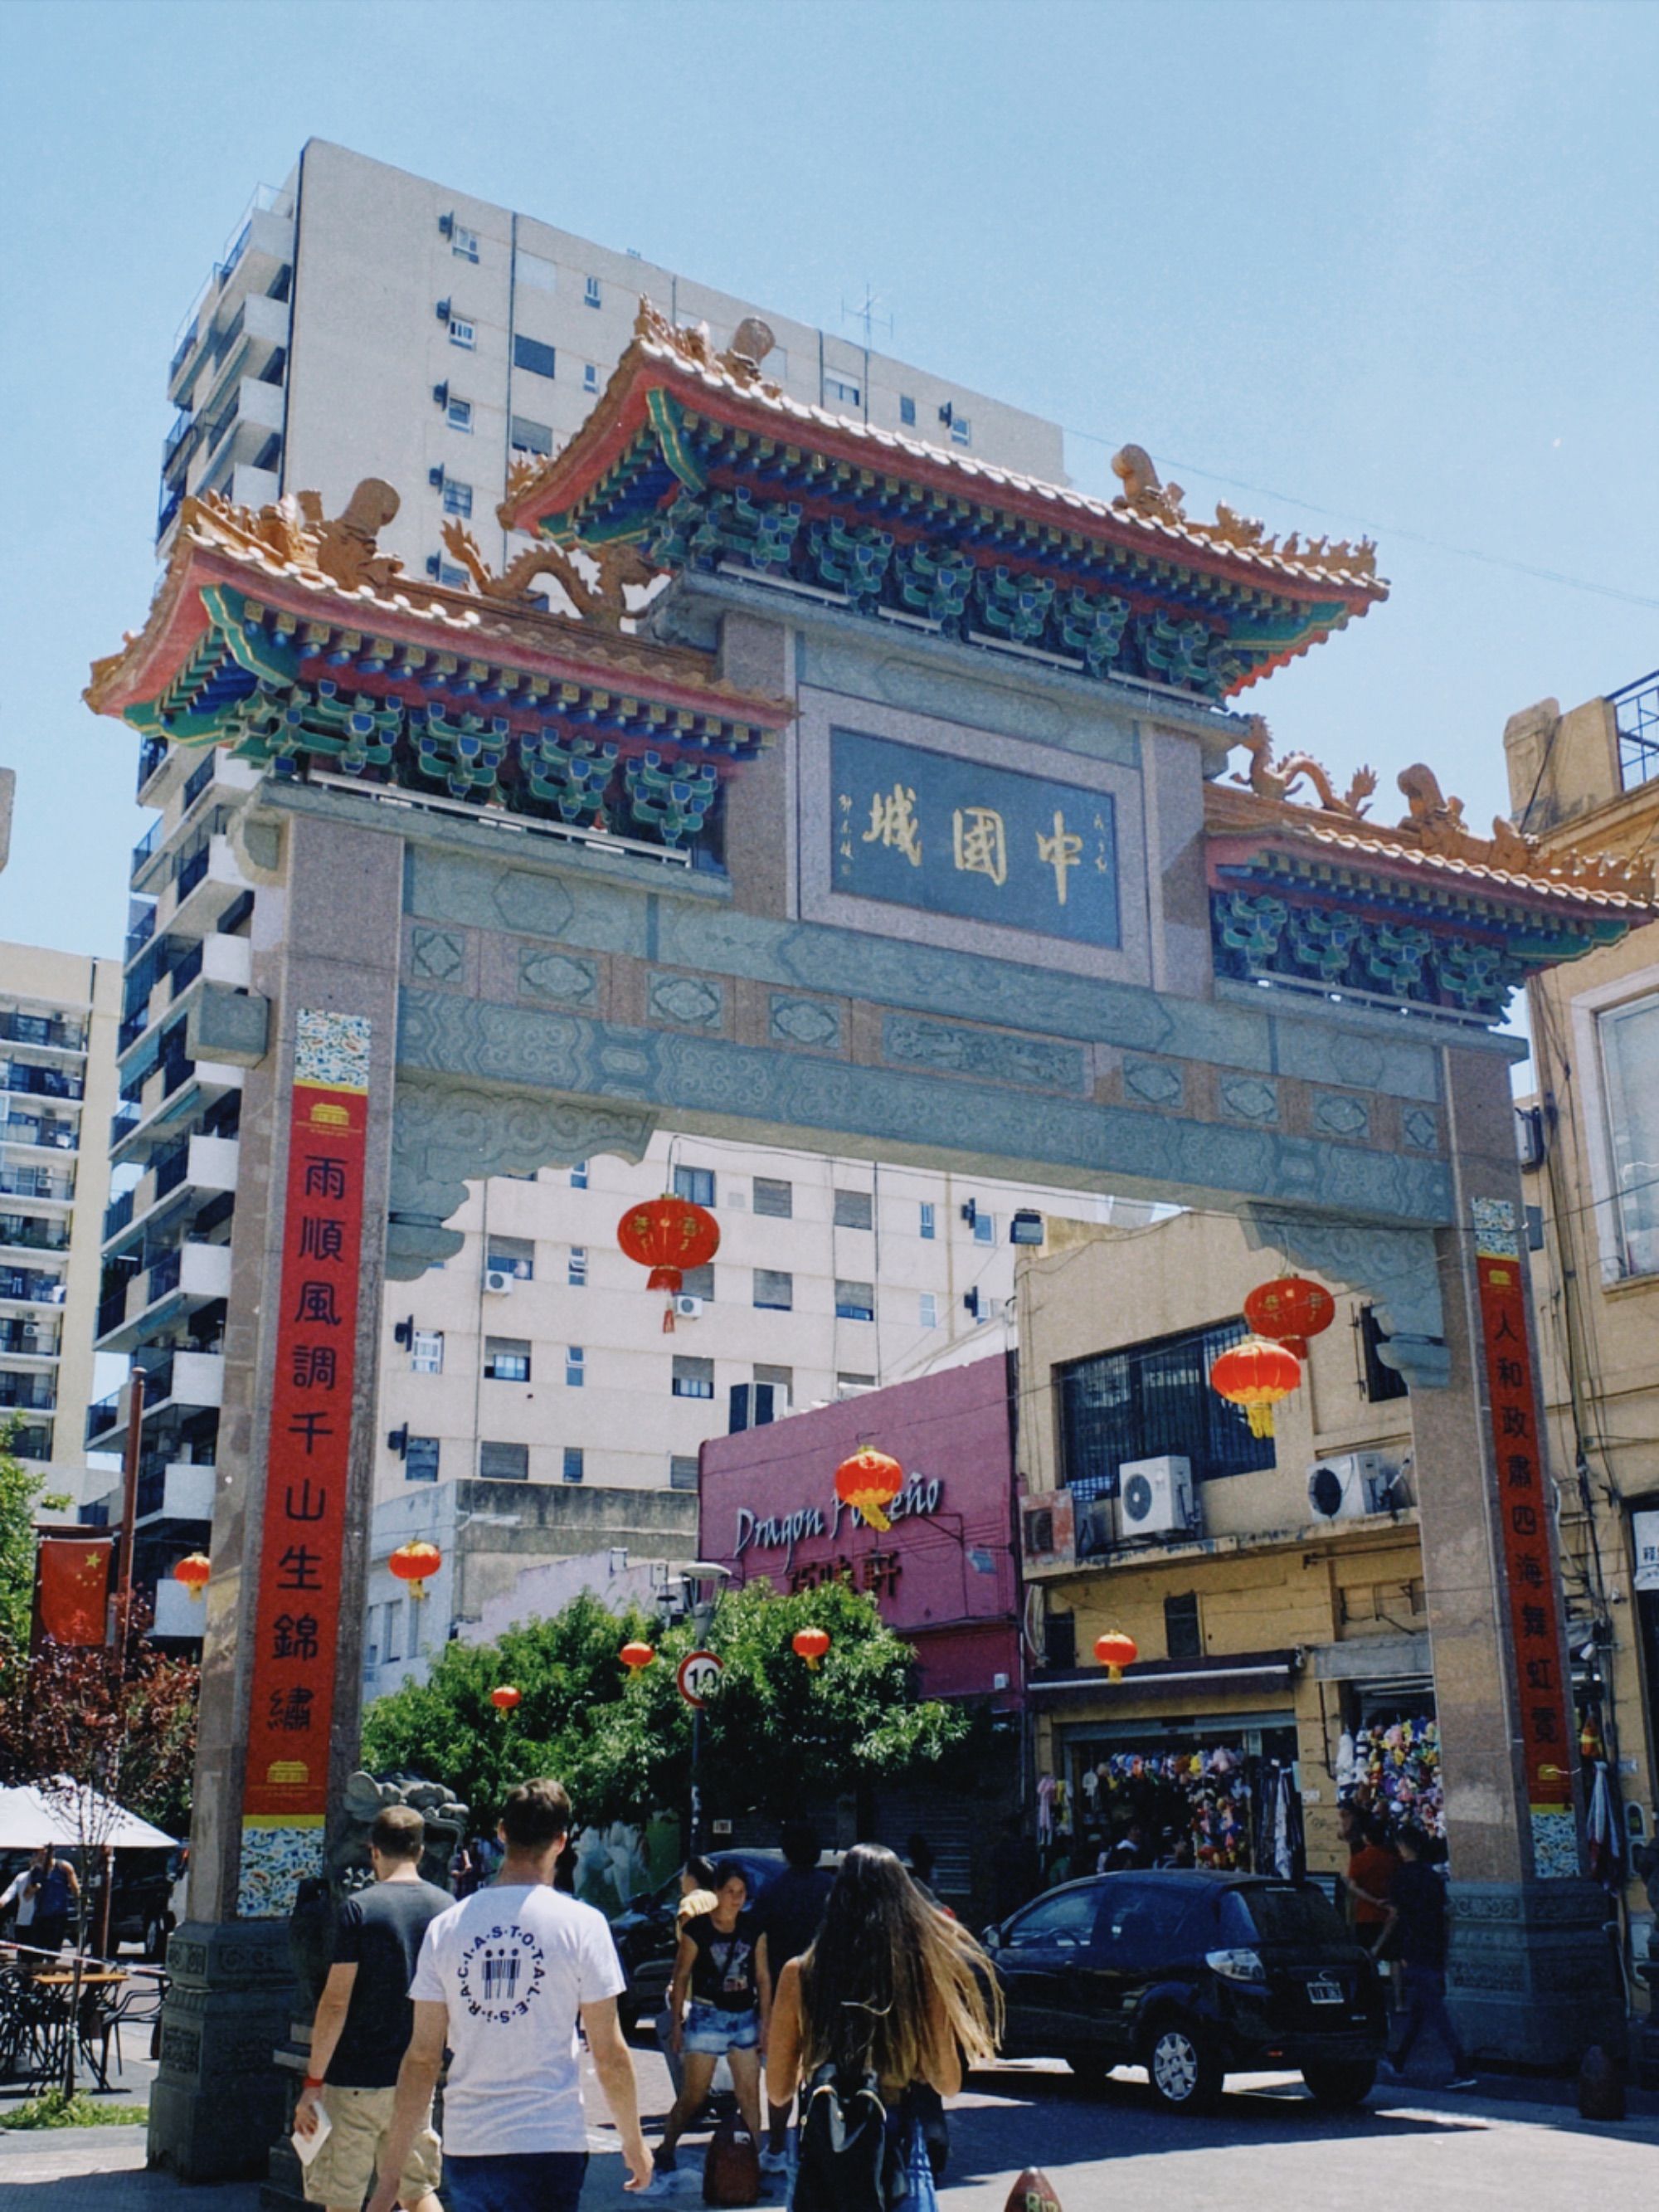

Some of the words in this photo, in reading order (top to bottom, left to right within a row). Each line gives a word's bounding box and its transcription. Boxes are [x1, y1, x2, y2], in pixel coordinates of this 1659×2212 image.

[266, 1154, 348, 1732] 雨順風調千山生錦繡
[734, 1506, 825, 1574] Dragon
[688, 1667, 718, 1691] 10
